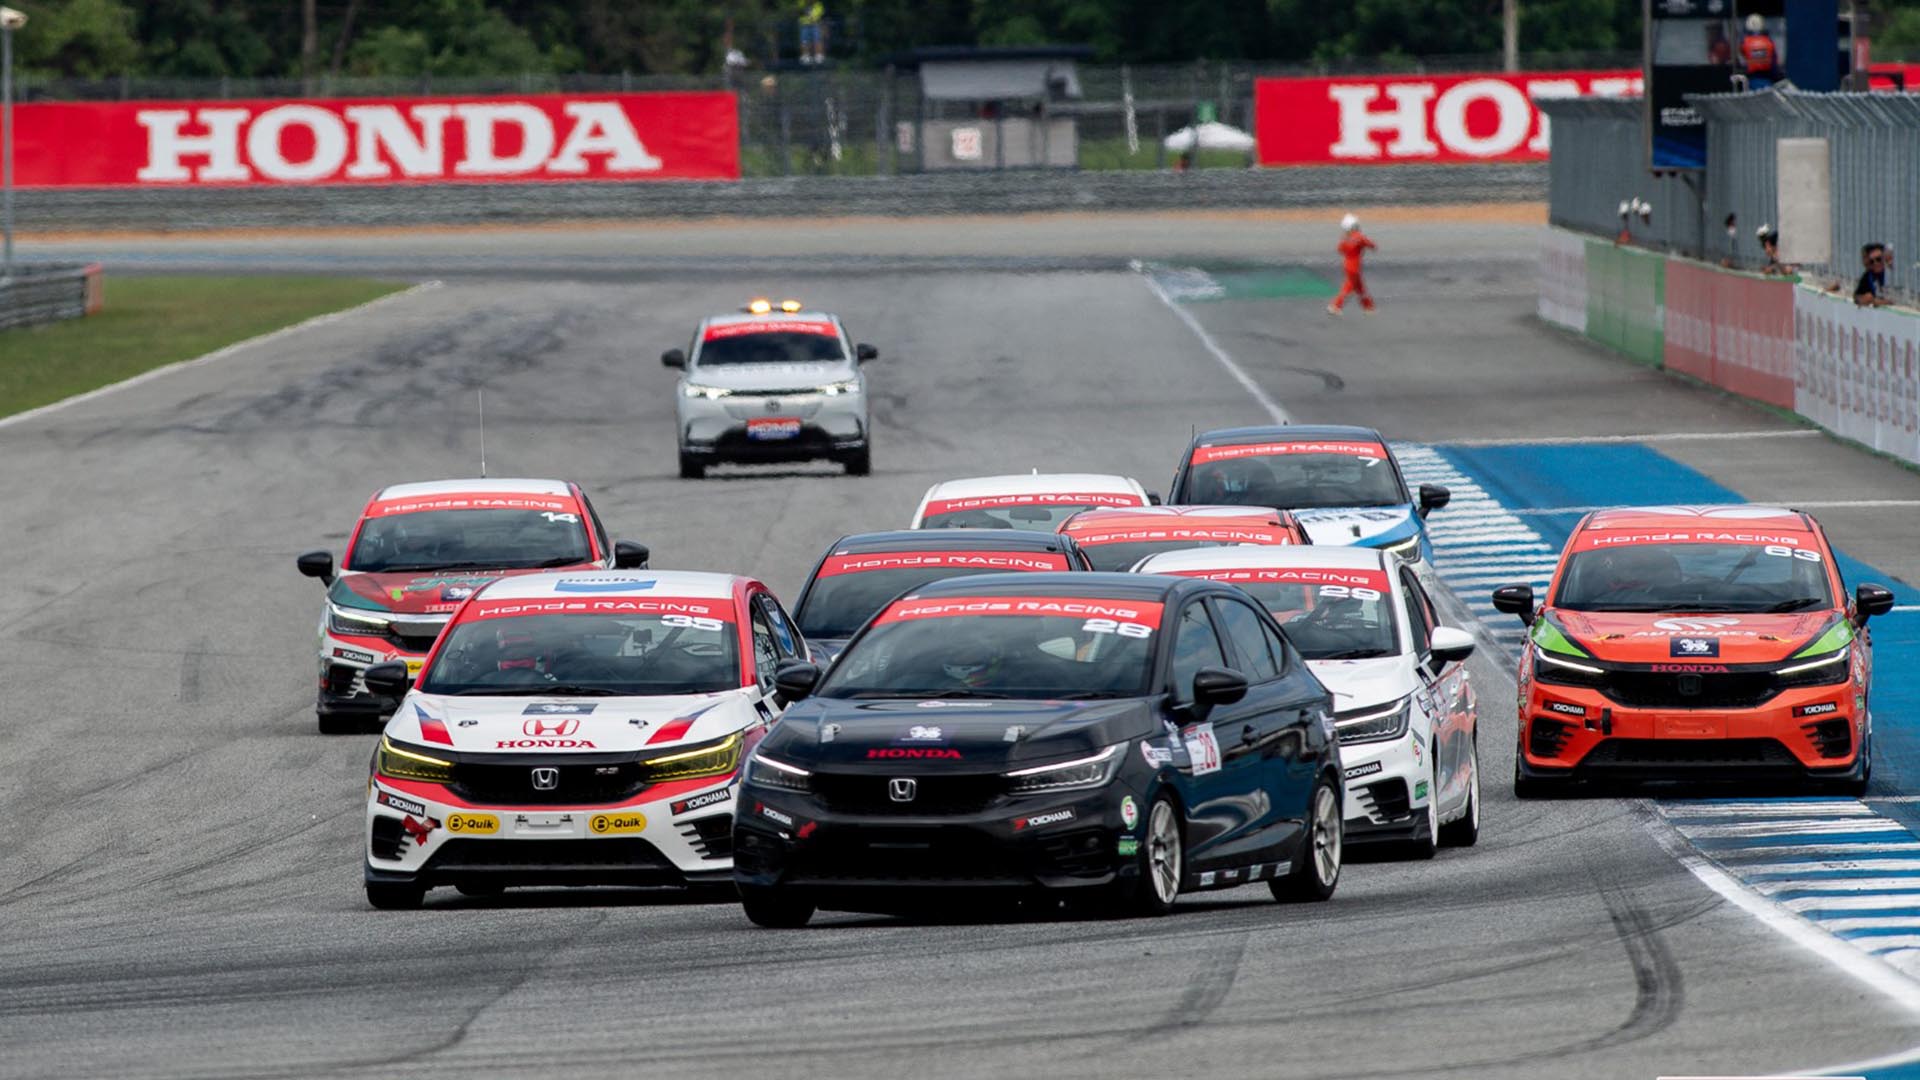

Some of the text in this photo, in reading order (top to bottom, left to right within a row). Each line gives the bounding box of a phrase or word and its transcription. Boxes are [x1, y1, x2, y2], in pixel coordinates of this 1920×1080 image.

[136, 101, 662, 181] HONDA
[1207, 444, 1375, 458] Honda RACING
[1358, 456, 1380, 467] 7
[383, 499, 563, 512] Honda RACING
[946, 494, 1133, 509] Honda RACING
[541, 511, 578, 524] 14
[1172, 529, 1273, 542] RACING
[1592, 531, 1799, 546] Honda RACING
[1763, 544, 1821, 563] 63
[842, 555, 1053, 570] Honda RACING
[1257, 570, 1370, 585] RACING
[1318, 584, 1381, 601] 29
[479, 601, 709, 617] Honda RACING
[898, 602, 1138, 619] Honda RACING
[660, 614, 724, 632] 35
[1081, 618, 1153, 639] 28
[1651, 664, 1730, 673] HONDA
[1552, 703, 1585, 715] YOKOHAMA
[1804, 702, 1837, 714] YOKOHAMA
[496, 739, 597, 749] HONDA
[866, 747, 963, 760] HONDA
[387, 797, 424, 816] YOKOHAMA
[683, 790, 731, 809] YOKOHAMA
[1027, 810, 1073, 828] YOKOHAMA
